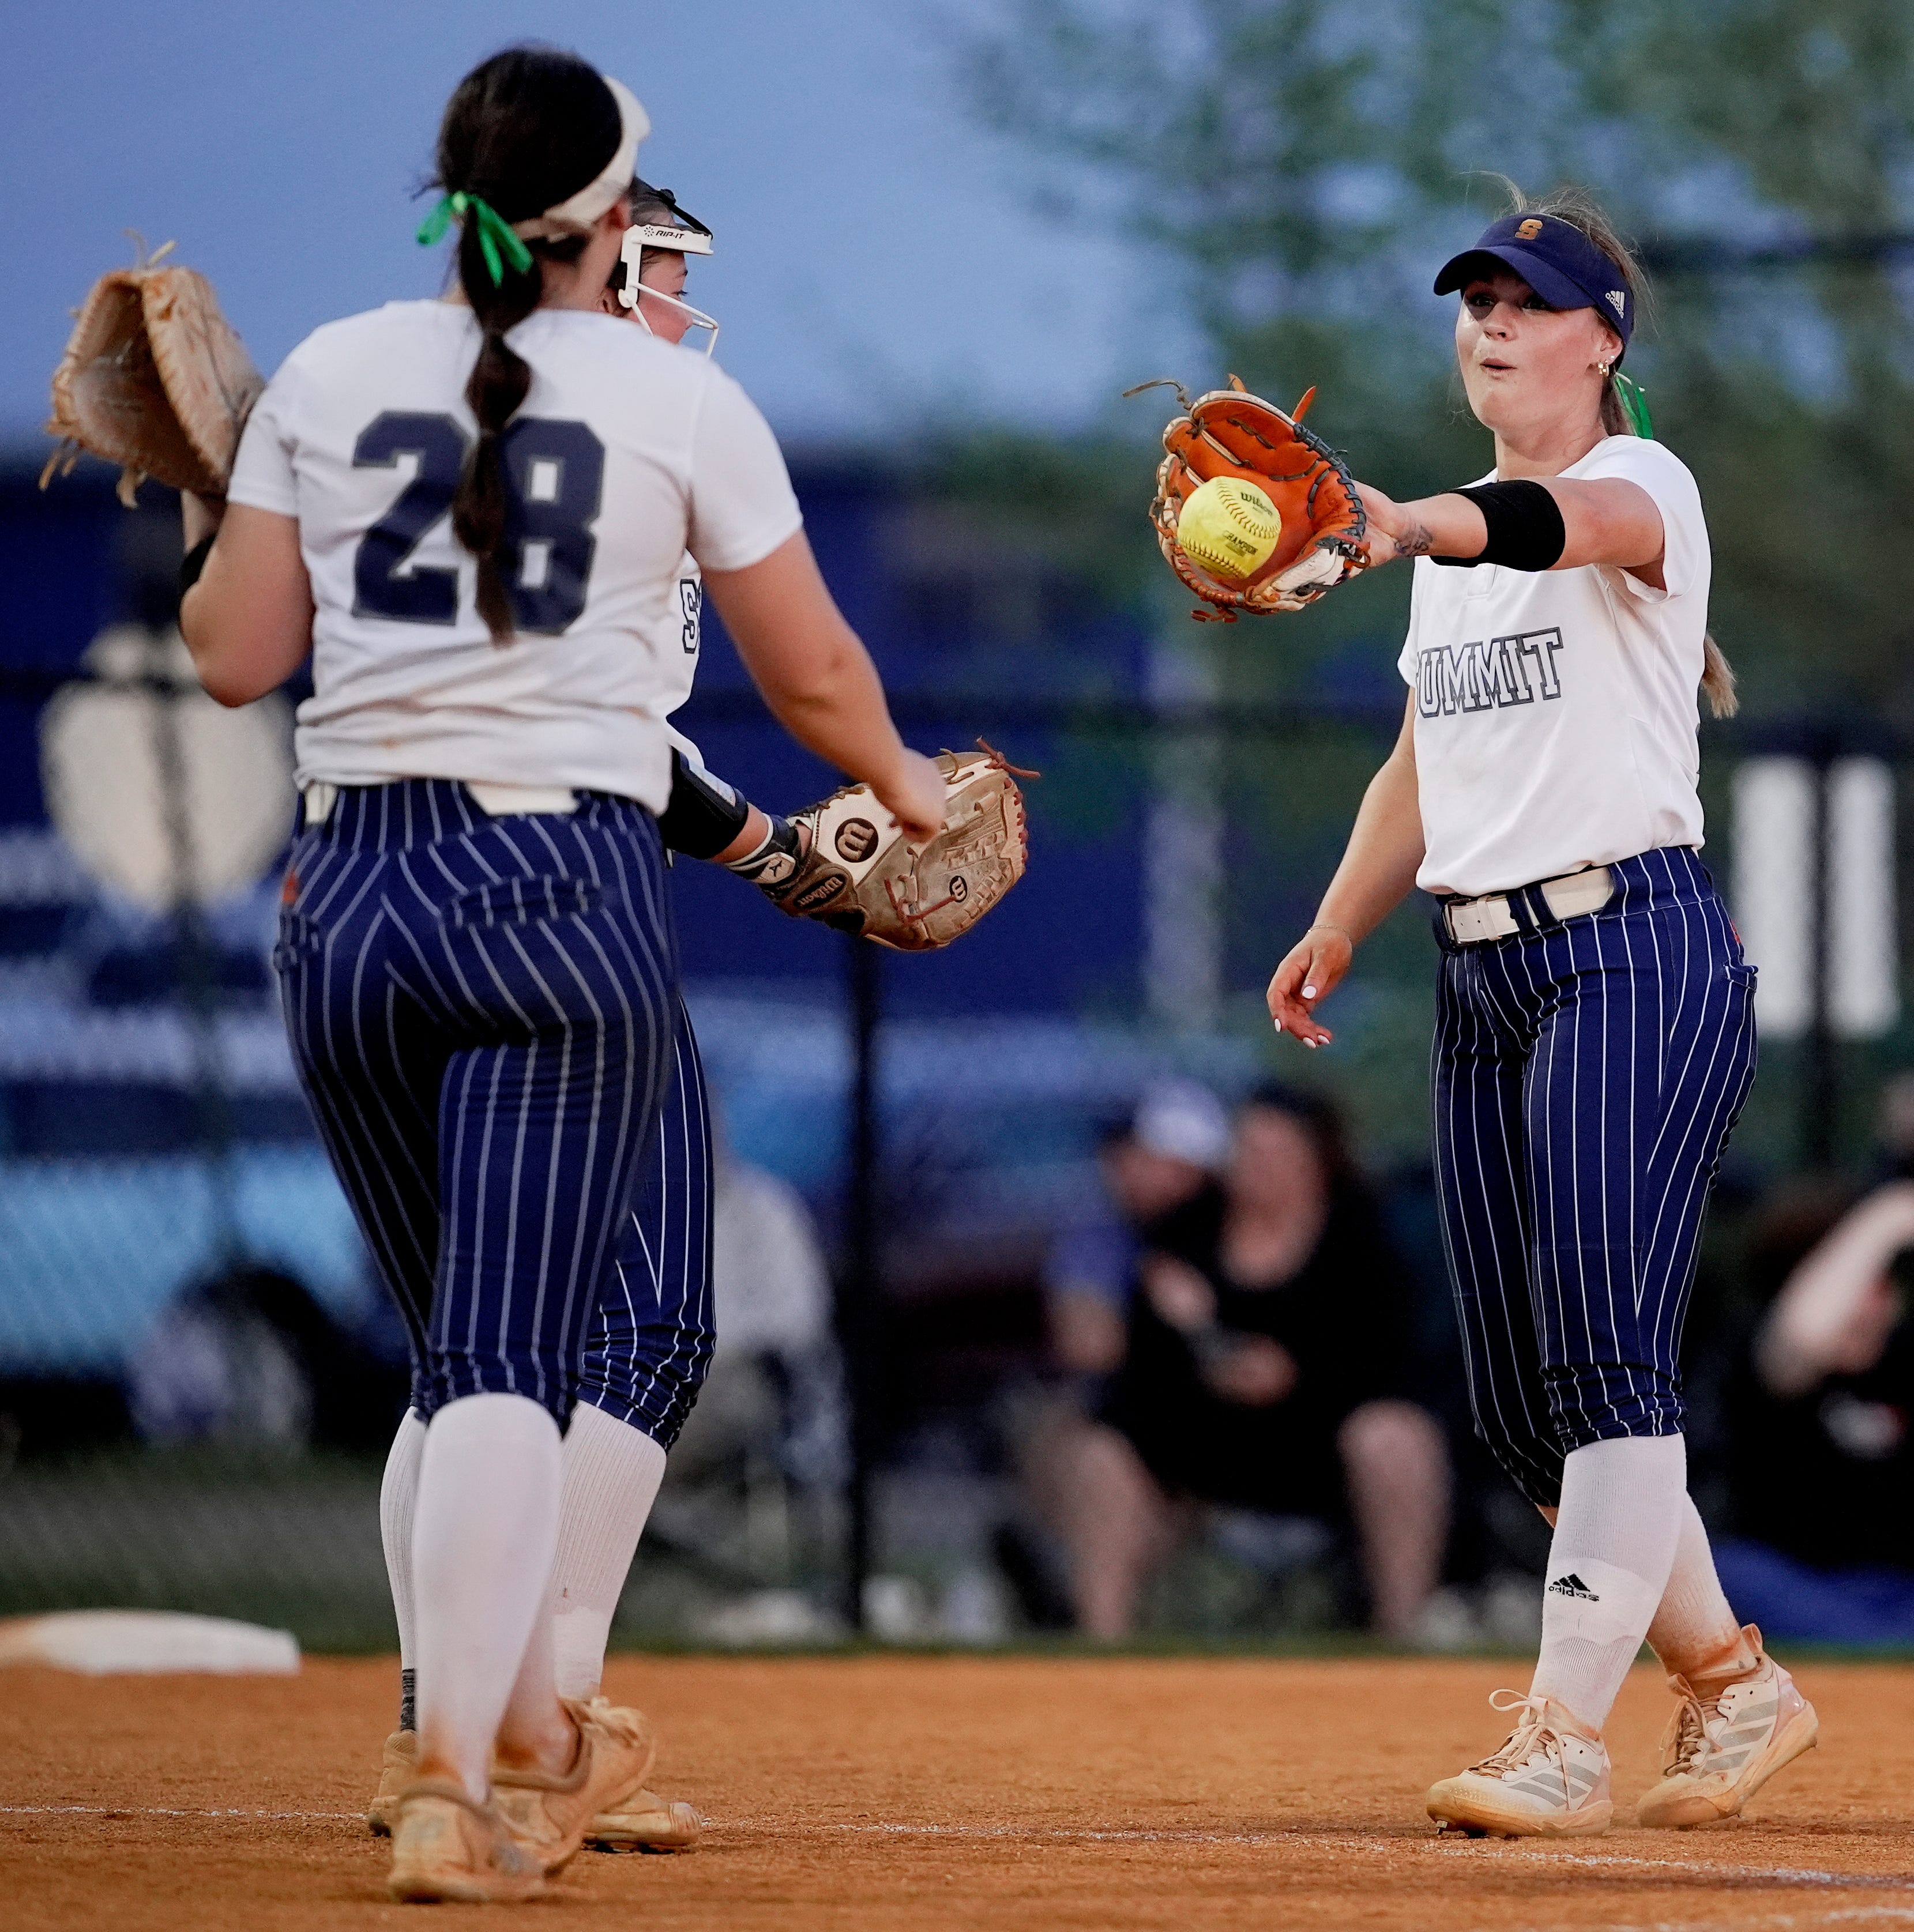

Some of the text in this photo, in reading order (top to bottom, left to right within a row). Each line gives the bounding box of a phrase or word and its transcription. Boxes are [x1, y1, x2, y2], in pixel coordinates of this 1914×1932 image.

[656, 230, 685, 239] RIP-IT
[1515, 219, 1543, 240] S
[1605, 292, 1625, 319] adidas
[351, 409, 606, 637] 28
[1416, 627, 1563, 718] UMMIT
[796, 876, 843, 907] Wilson
[1548, 1585, 1600, 1602] adidas
